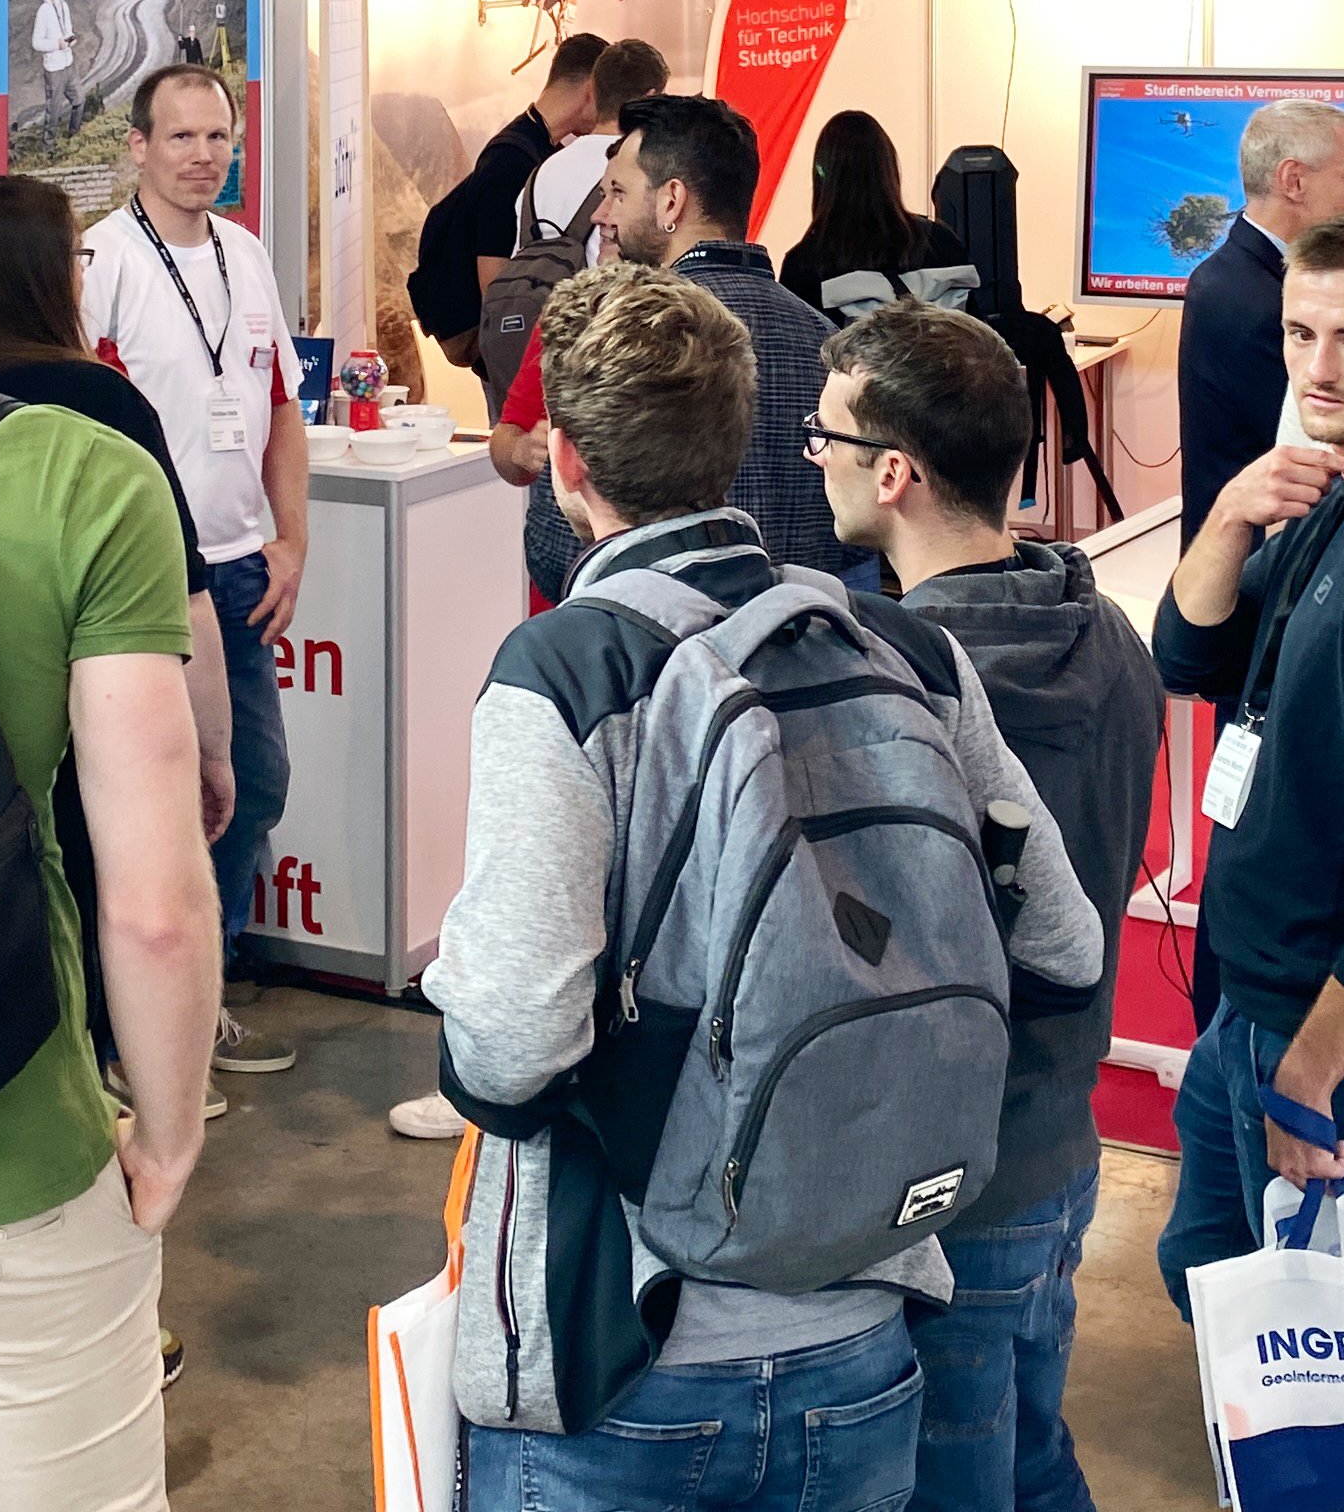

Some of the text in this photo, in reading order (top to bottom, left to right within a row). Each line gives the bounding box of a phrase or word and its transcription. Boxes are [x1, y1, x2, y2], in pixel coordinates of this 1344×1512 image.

[737, 0, 835, 26] Hochschule
[737, 20, 834, 47] für Technik
[738, 44, 818, 69] Stuttgart
[1144, 83, 1243, 98] Studienbereich
[1246, 85, 1332, 101] Vermessung
[1091, 277, 1113, 289] Wir
[1115, 279, 1164, 291] arbeiten
